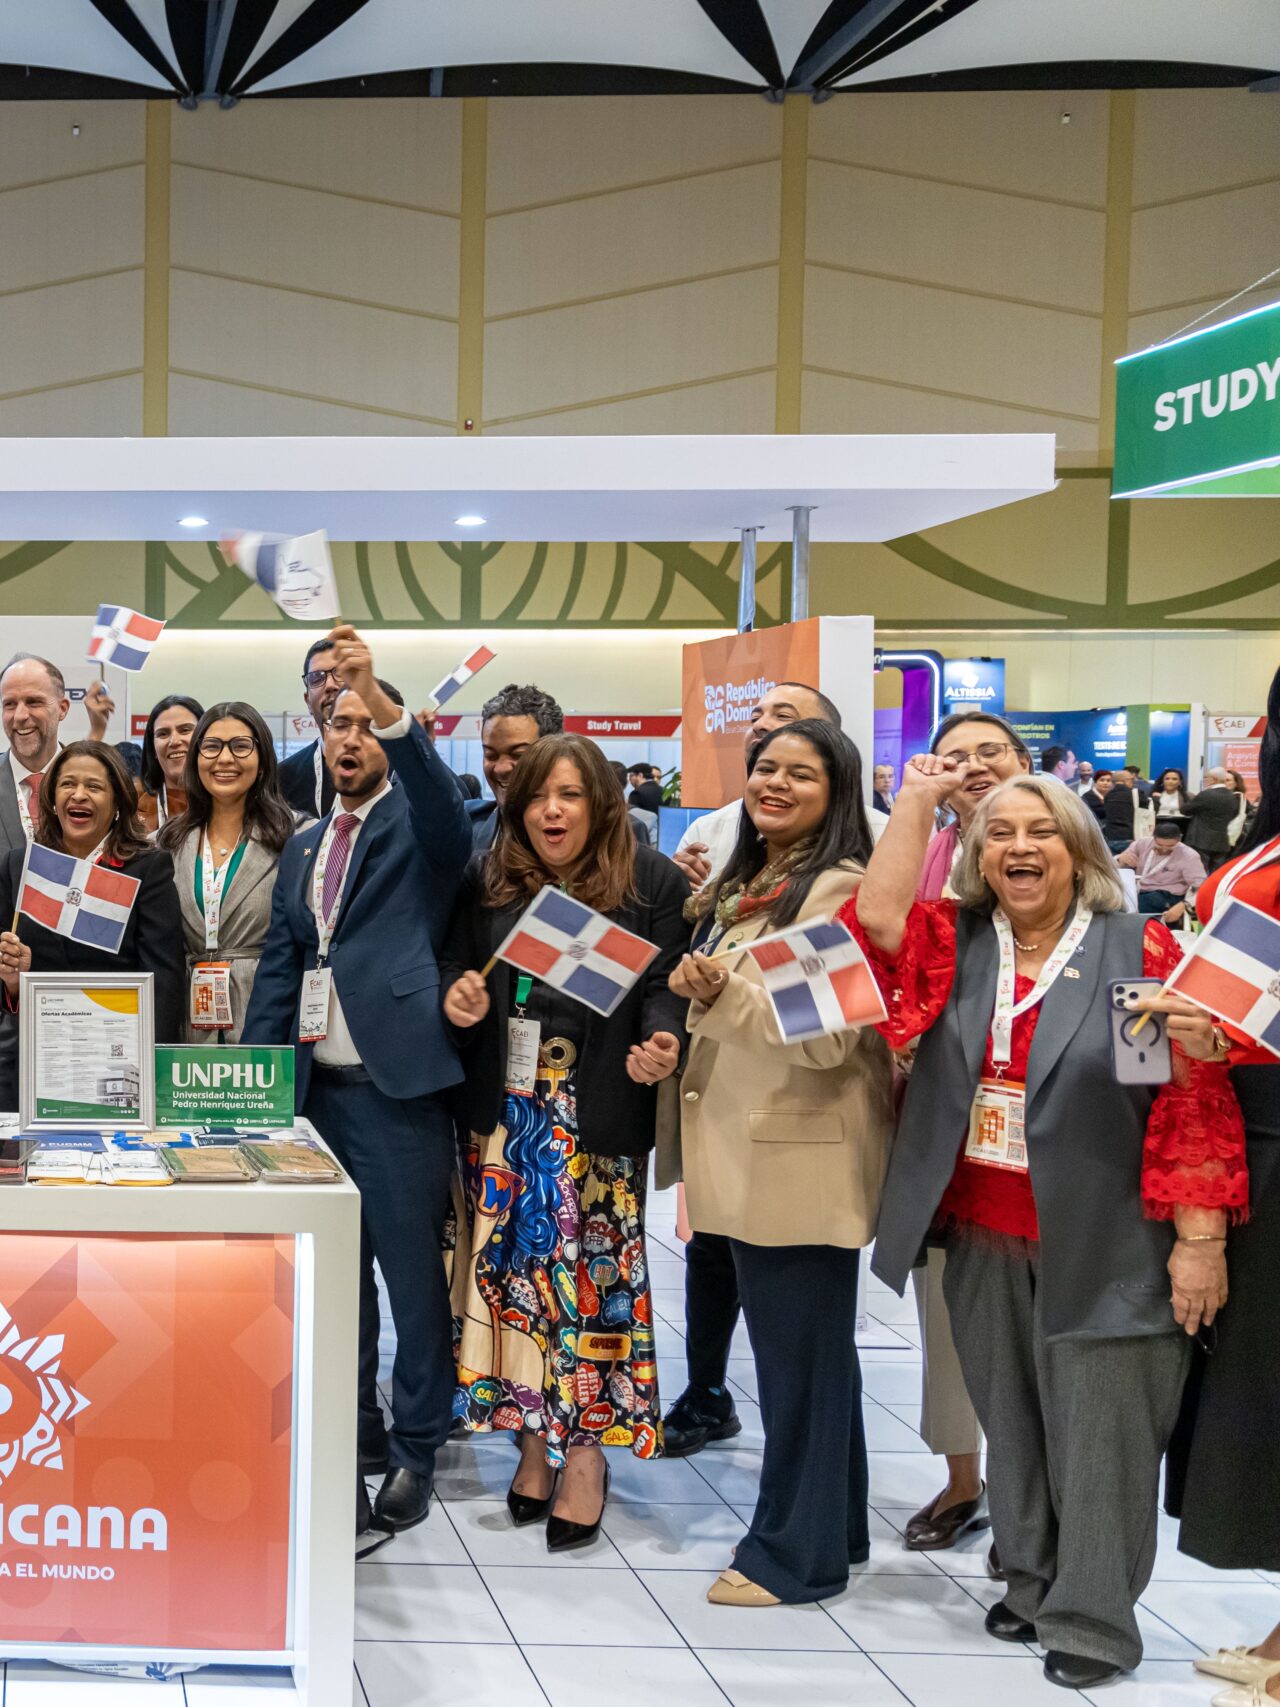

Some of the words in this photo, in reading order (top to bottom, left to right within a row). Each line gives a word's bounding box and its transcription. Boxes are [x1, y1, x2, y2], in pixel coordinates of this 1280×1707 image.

[1153, 357, 1280, 431] STUDY
[944, 686, 996, 697] ALTISSIA
[587, 720, 612, 733] Study
[614, 720, 641, 731] Travel
[1224, 720, 1246, 728] CAEI
[172, 1062, 275, 1088] UNPHU
[173, 1091, 225, 1099] Universidad
[227, 1091, 266, 1099] Nacional
[173, 1100, 198, 1108] Pedro
[200, 1100, 245, 1110] Henríquez
[247, 1101, 274, 1109] Ureña
[594, 1264, 613, 1280] HIT
[577, 1368, 589, 1404] SELLER
[588, 1372, 600, 1396] BEST
[501, 1407, 520, 1420] BEST
[588, 1412, 610, 1423] HOT
[494, 1415, 520, 1430] SELLER
[605, 1431, 630, 1444] SALE
[634, 1430, 650, 1454] HOT
[16, 1563, 38, 1579] EL
[41, 1564, 115, 1581] MUNDO
